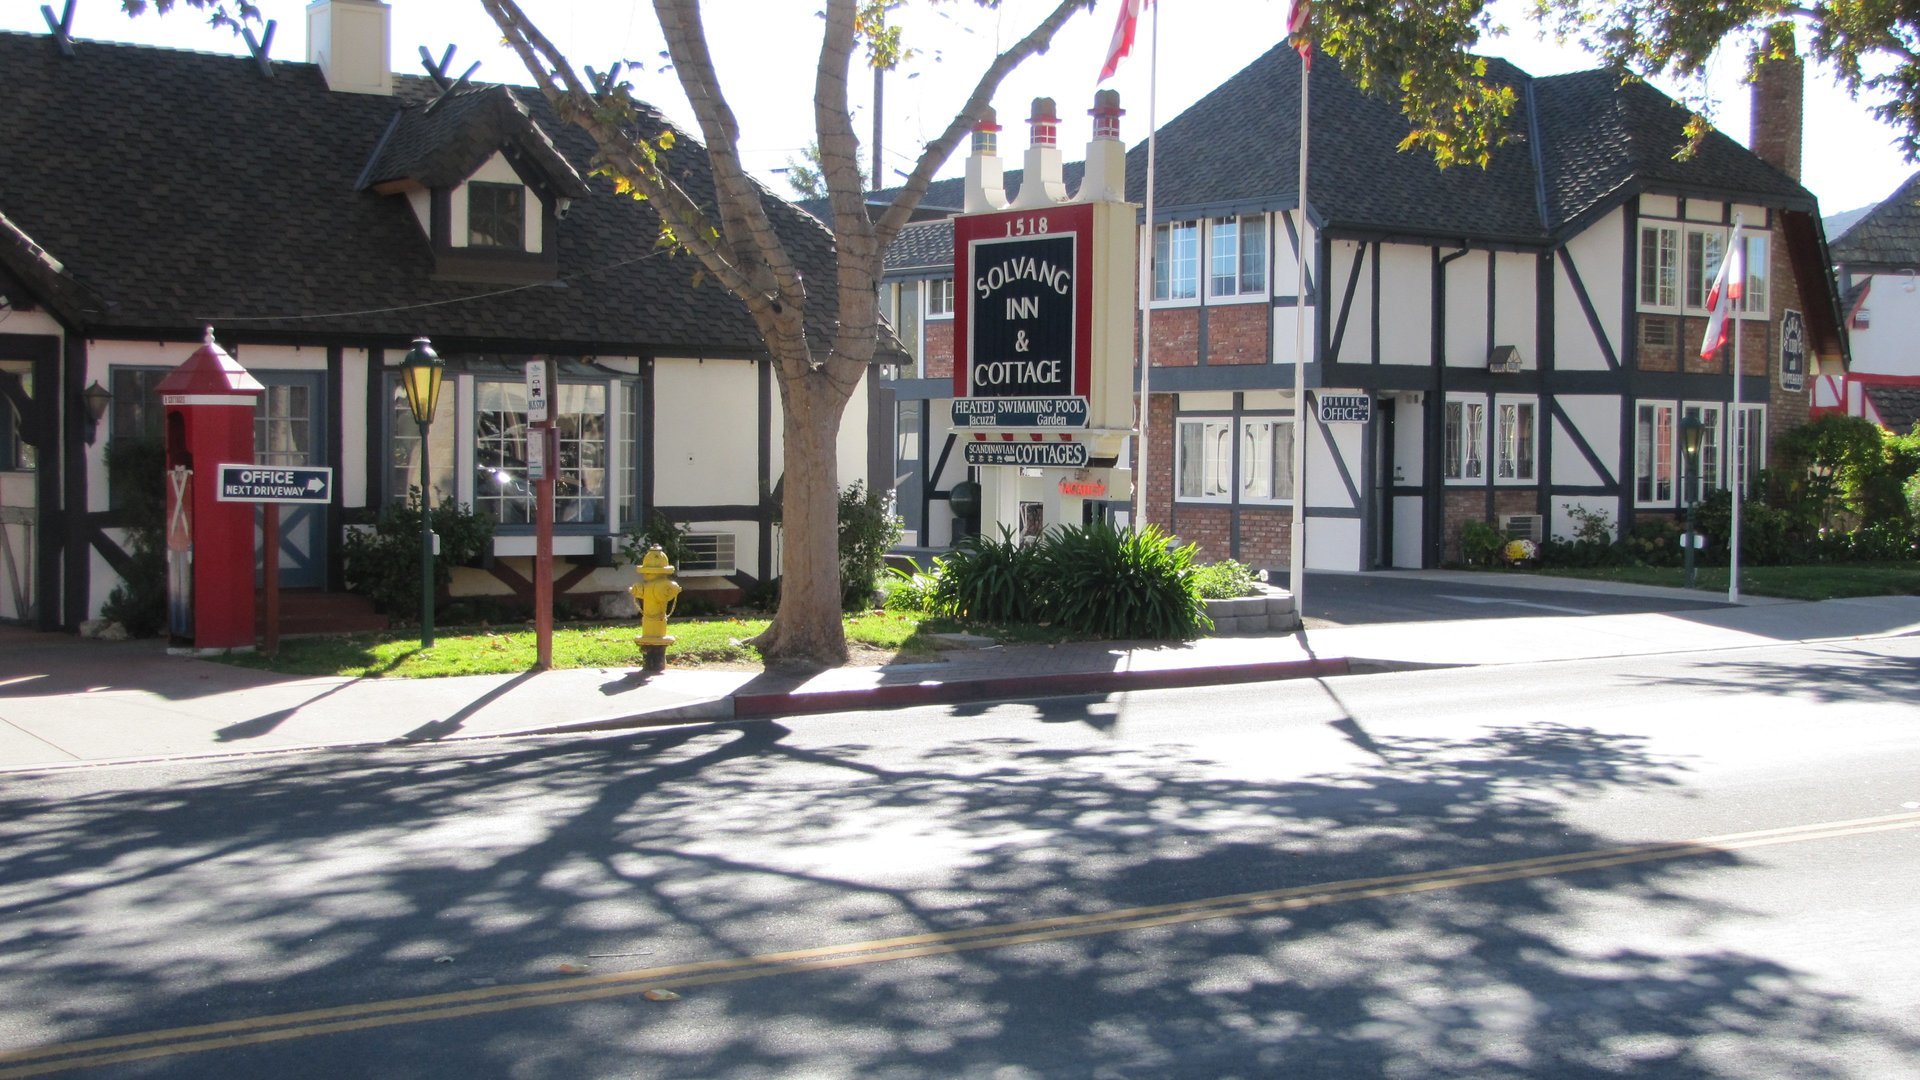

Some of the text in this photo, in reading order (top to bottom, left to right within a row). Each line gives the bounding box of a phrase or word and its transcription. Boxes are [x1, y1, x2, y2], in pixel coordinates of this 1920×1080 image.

[1005, 217, 1048, 237] 1518
[976, 256, 1071, 299] SOLVANG
[1006, 296, 1039, 320] INN
[1015, 330, 1029, 352] &
[974, 360, 1061, 387] COTTAGE
[955, 400, 1084, 414] HEATED SWIMMING POOL
[1322, 407, 1359, 420] OFFICE
[968, 413, 1067, 427] Jacuzzi Garden
[968, 444, 1083, 465] SCANDINAVIAN COTTAGES
[241, 471, 295, 484] OFFICE
[226, 485, 306, 496] NEXT DRIVEWAY
